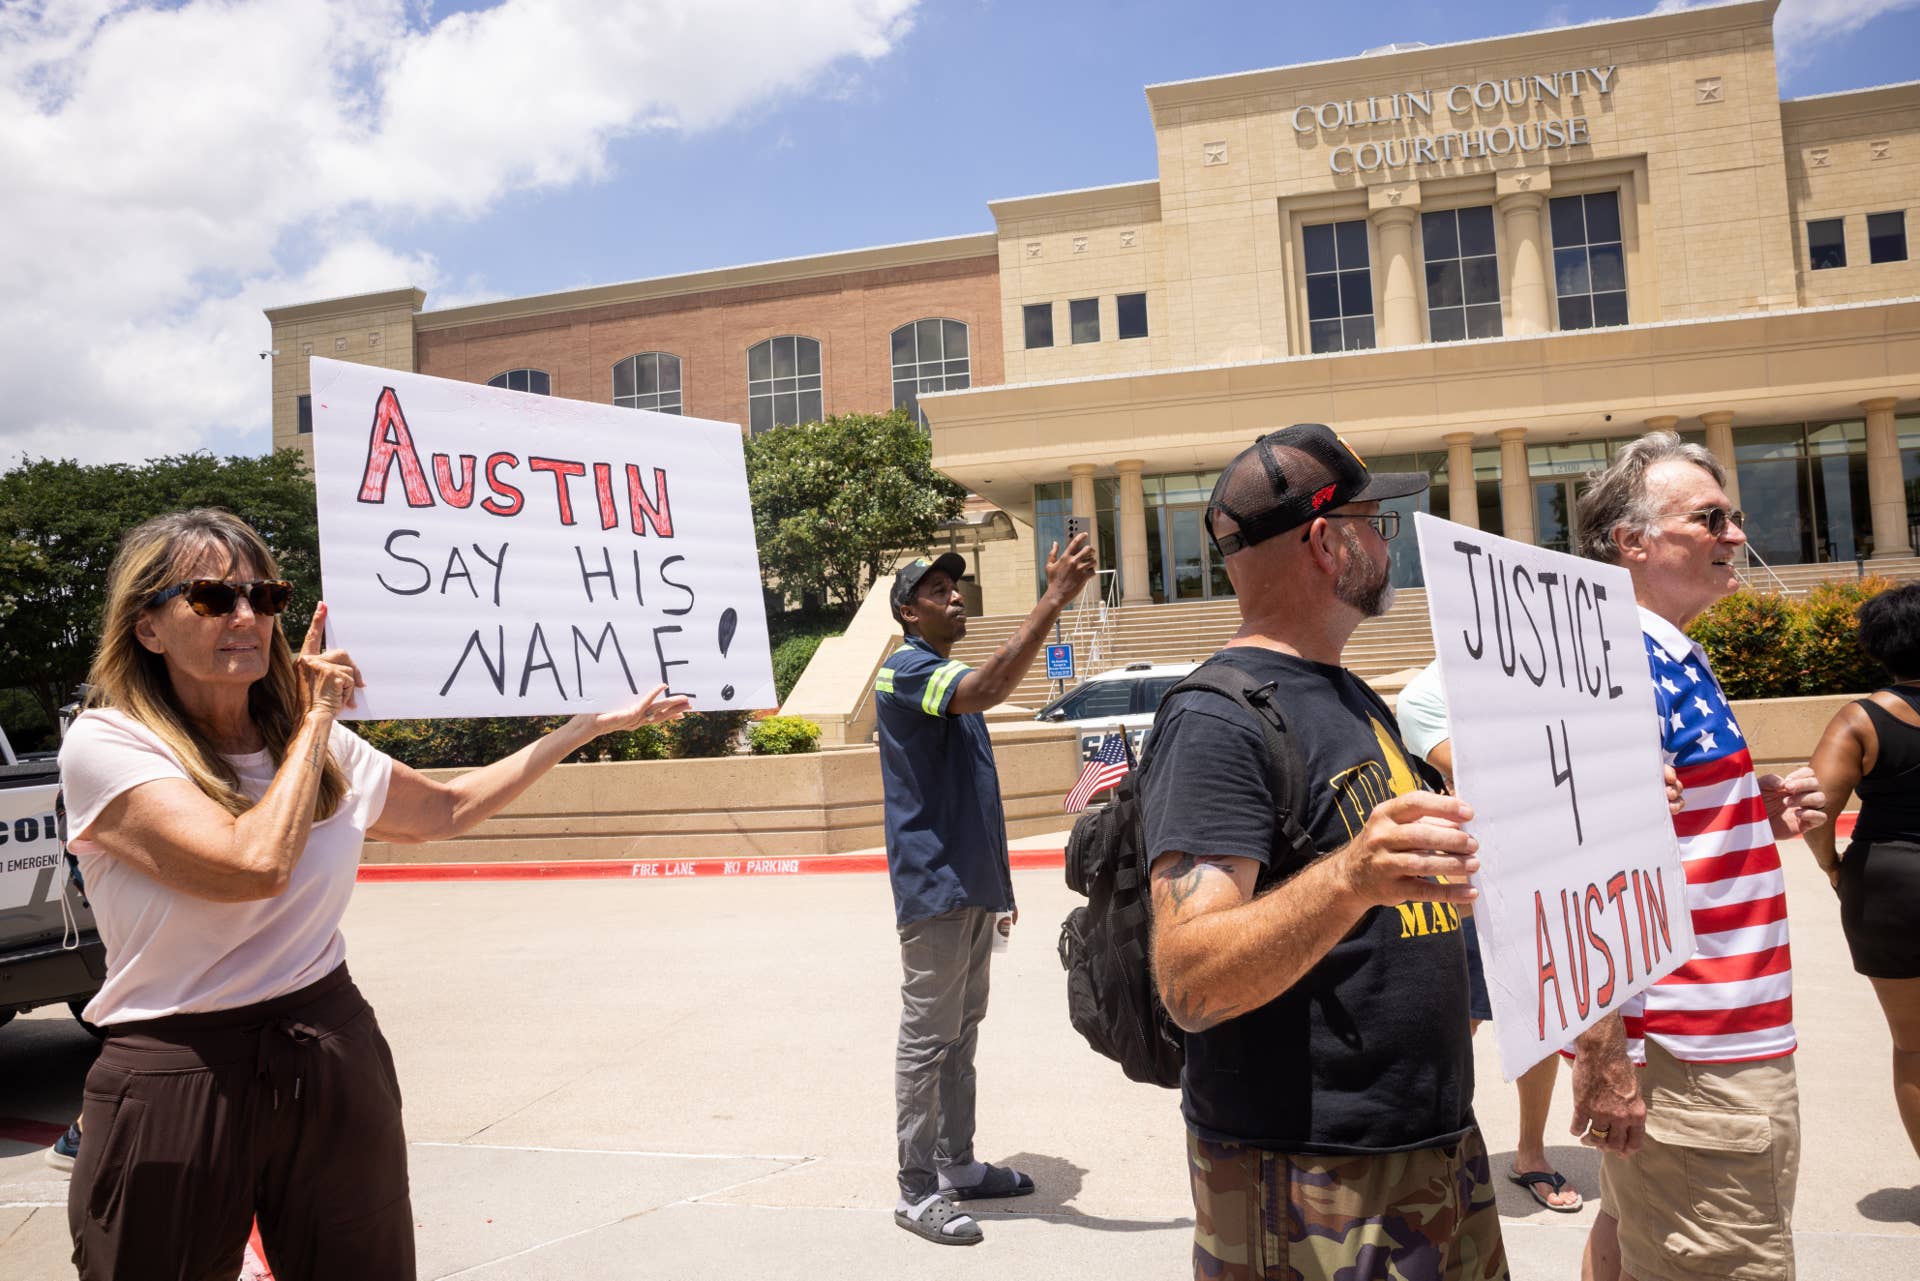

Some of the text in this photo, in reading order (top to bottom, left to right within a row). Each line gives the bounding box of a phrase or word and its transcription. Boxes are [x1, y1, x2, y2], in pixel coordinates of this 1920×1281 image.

[1291, 65, 1617, 132] COLLIN COUNTY
[1329, 117, 1592, 174] COURTHOUSE
[377, 529, 695, 616] SAY HIS
[439, 608, 738, 701] NAME!
[1454, 541, 1623, 699] JUSTICE
[1546, 720, 1583, 845] 4
[632, 859, 799, 876] FIRE LANE NO PARKING
[1535, 867, 1673, 1041] AUSTIN
